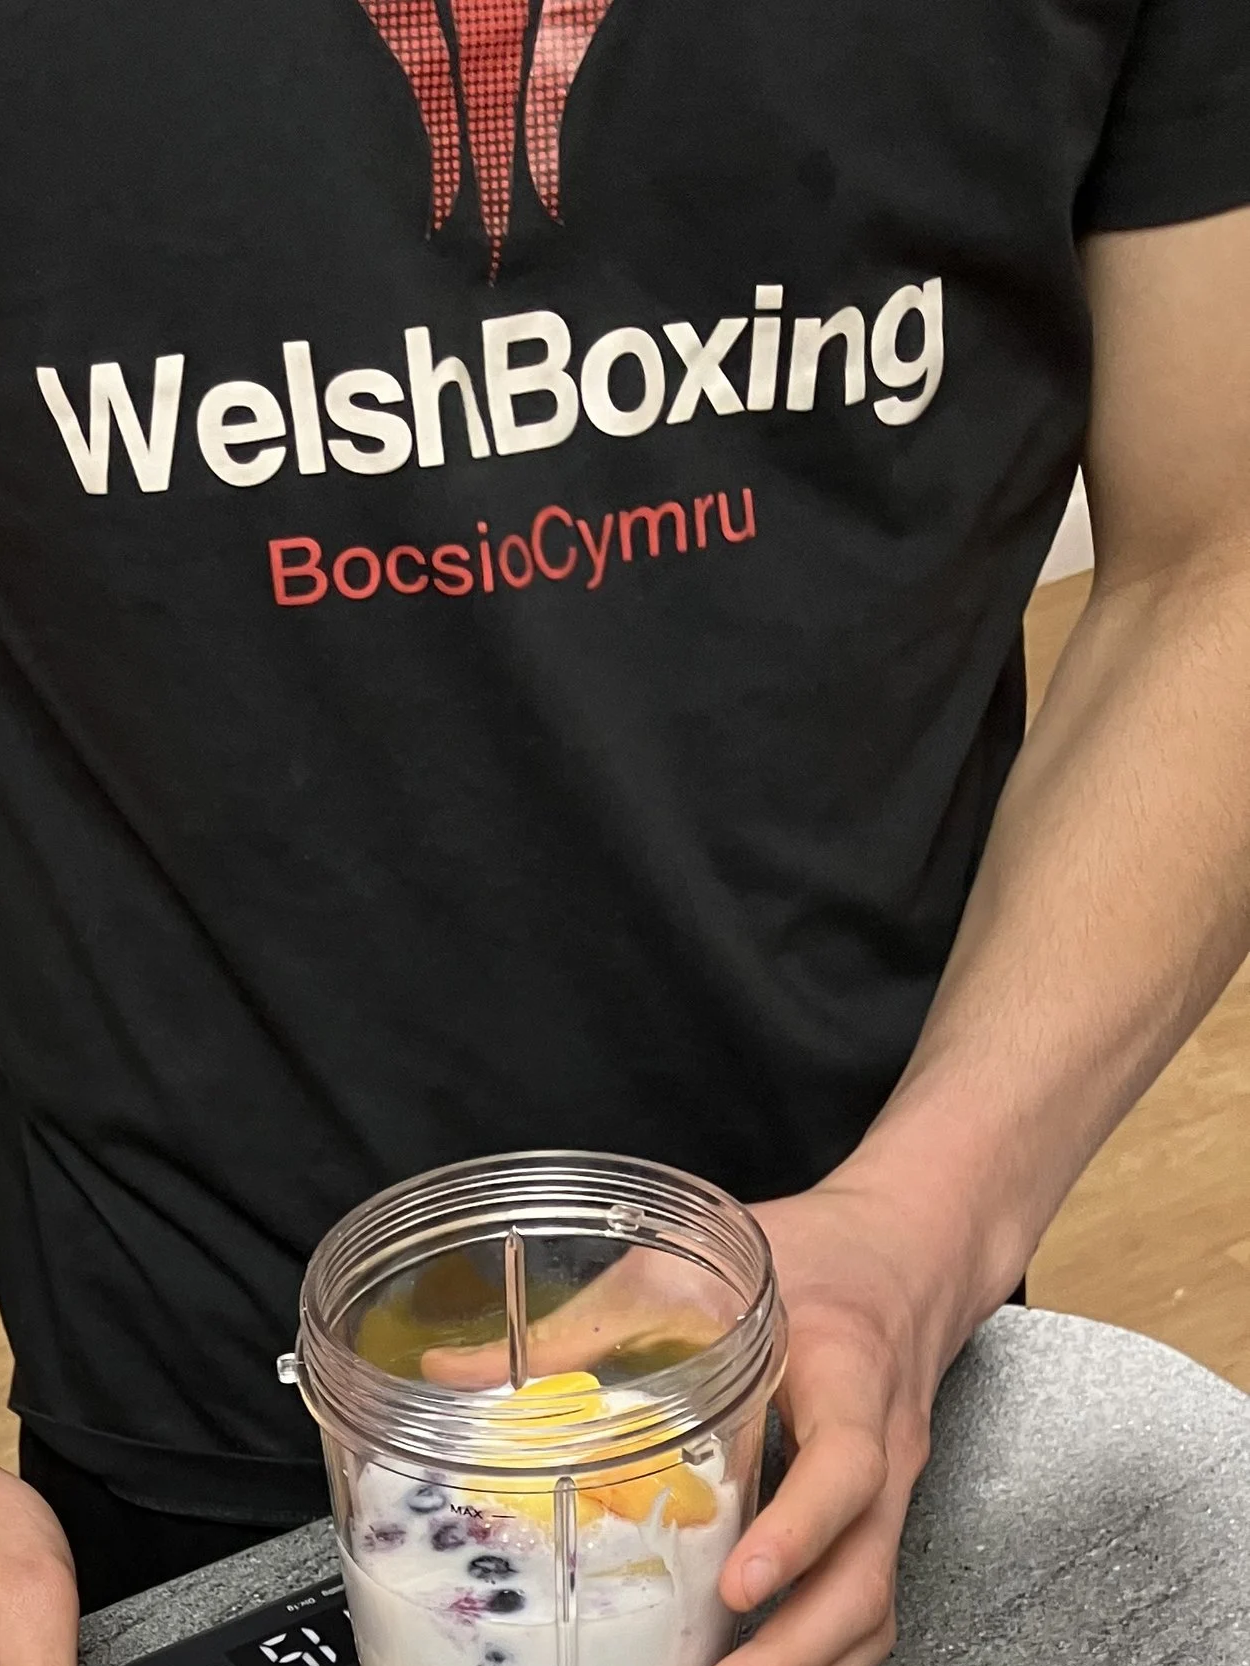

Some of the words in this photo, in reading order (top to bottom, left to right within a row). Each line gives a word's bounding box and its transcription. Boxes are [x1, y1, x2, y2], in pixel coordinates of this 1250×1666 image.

[37, 278, 943, 494] WelshBoxing
[269, 489, 755, 606] BocsioCymru
[450, 1503, 483, 1520] MAX
